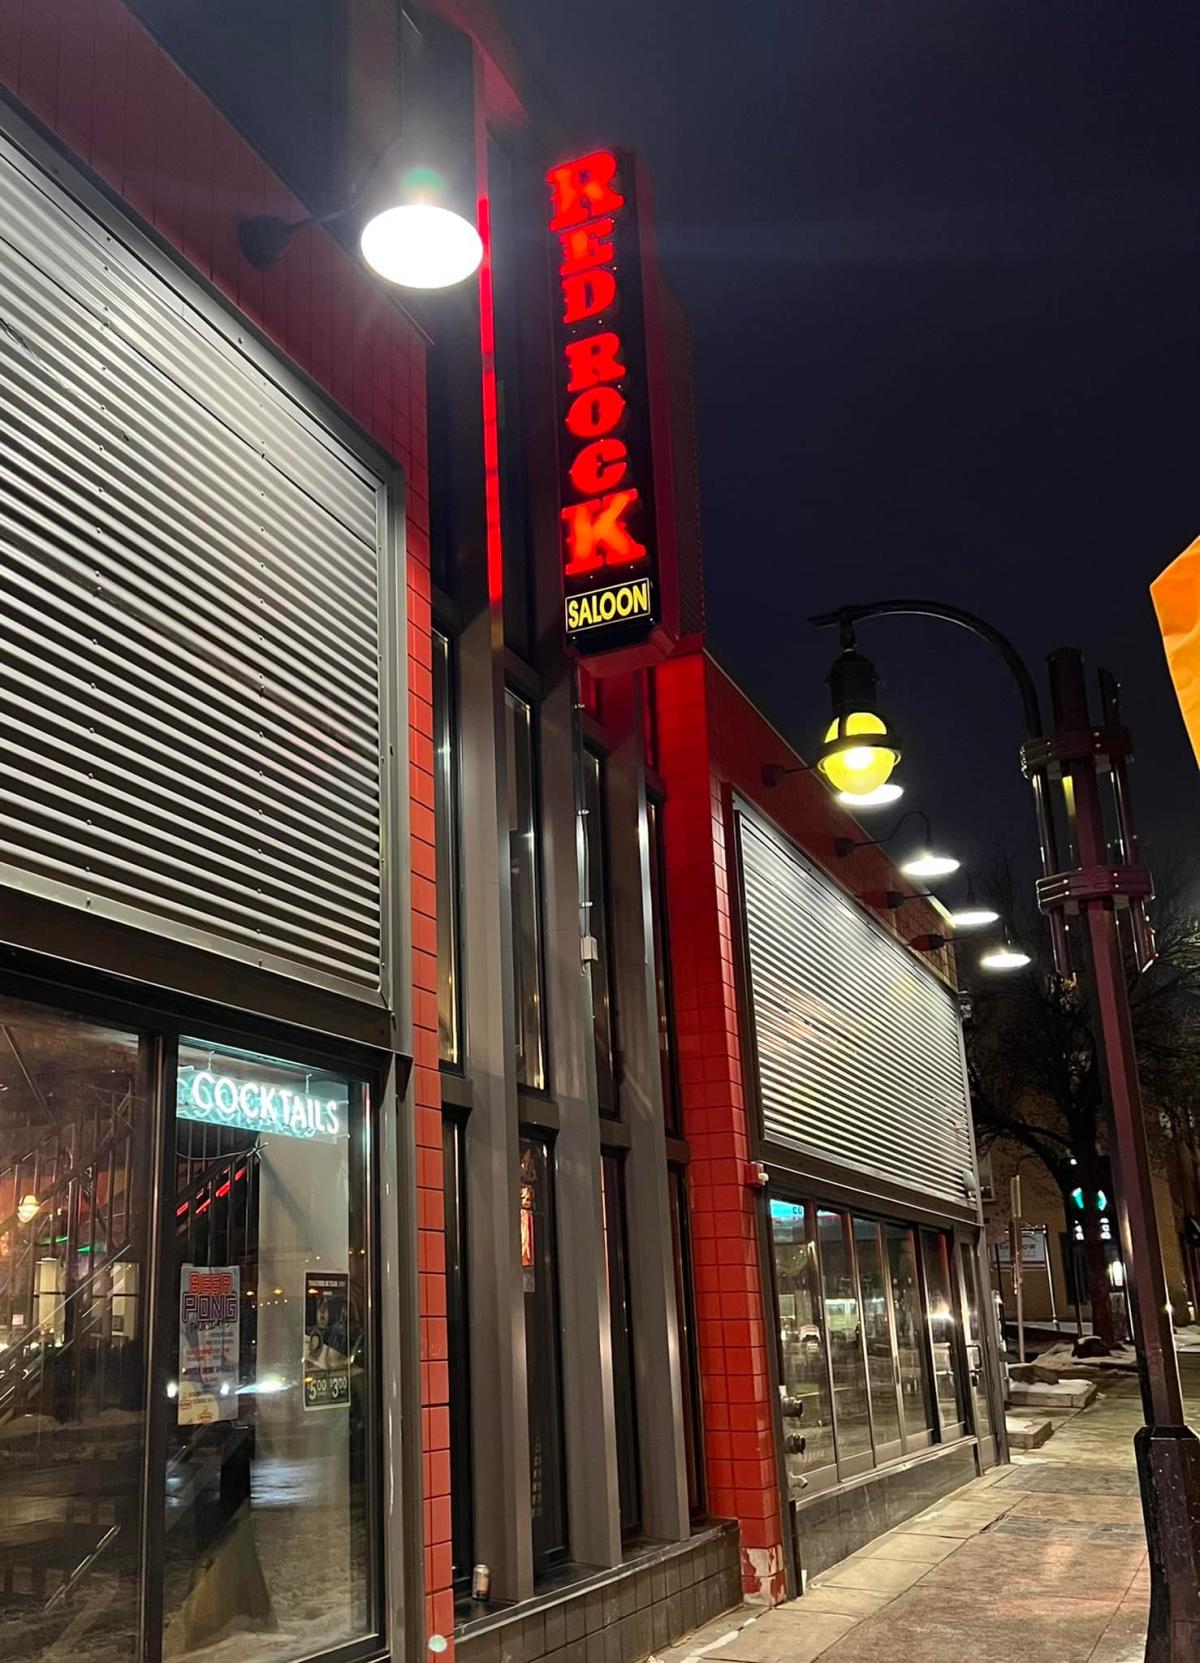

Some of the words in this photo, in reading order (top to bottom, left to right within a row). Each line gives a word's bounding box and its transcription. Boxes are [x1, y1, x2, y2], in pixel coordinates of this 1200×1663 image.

[546, 150, 625, 325] RED
[560, 331, 648, 577] ROCK
[568, 583, 647, 628] SALOON
[191, 1072, 340, 1135] COCKTAILS
[182, 1294, 238, 1323] PONG
[189, 1272, 233, 1295] BEER
